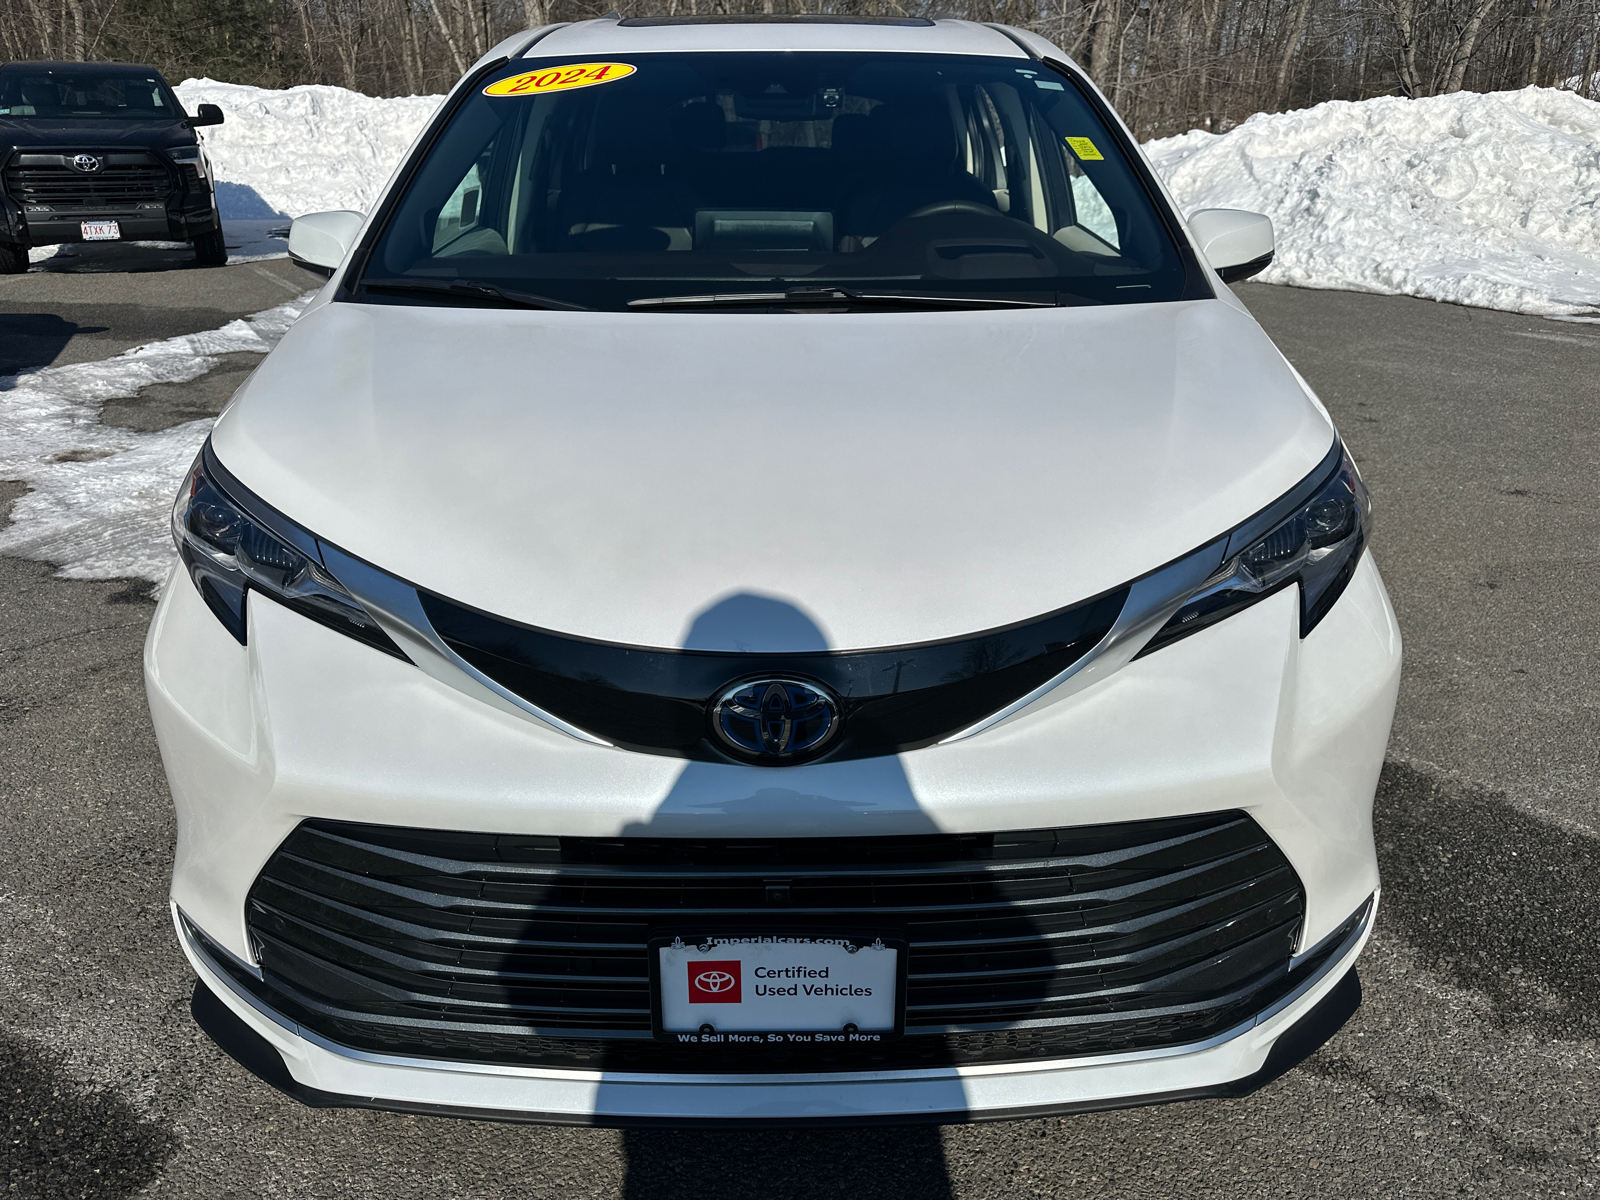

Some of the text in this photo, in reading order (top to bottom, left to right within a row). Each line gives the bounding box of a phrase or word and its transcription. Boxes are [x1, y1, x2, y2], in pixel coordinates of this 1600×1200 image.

[508, 65, 612, 93] 2024
[83, 225, 119, 235] 4TXK 73
[706, 935, 850, 946] Imperialcars.com
[754, 966, 829, 979] Certified
[755, 984, 873, 996] Used Vehicles
[677, 1033, 881, 1044] We Sell More, So You Save More
